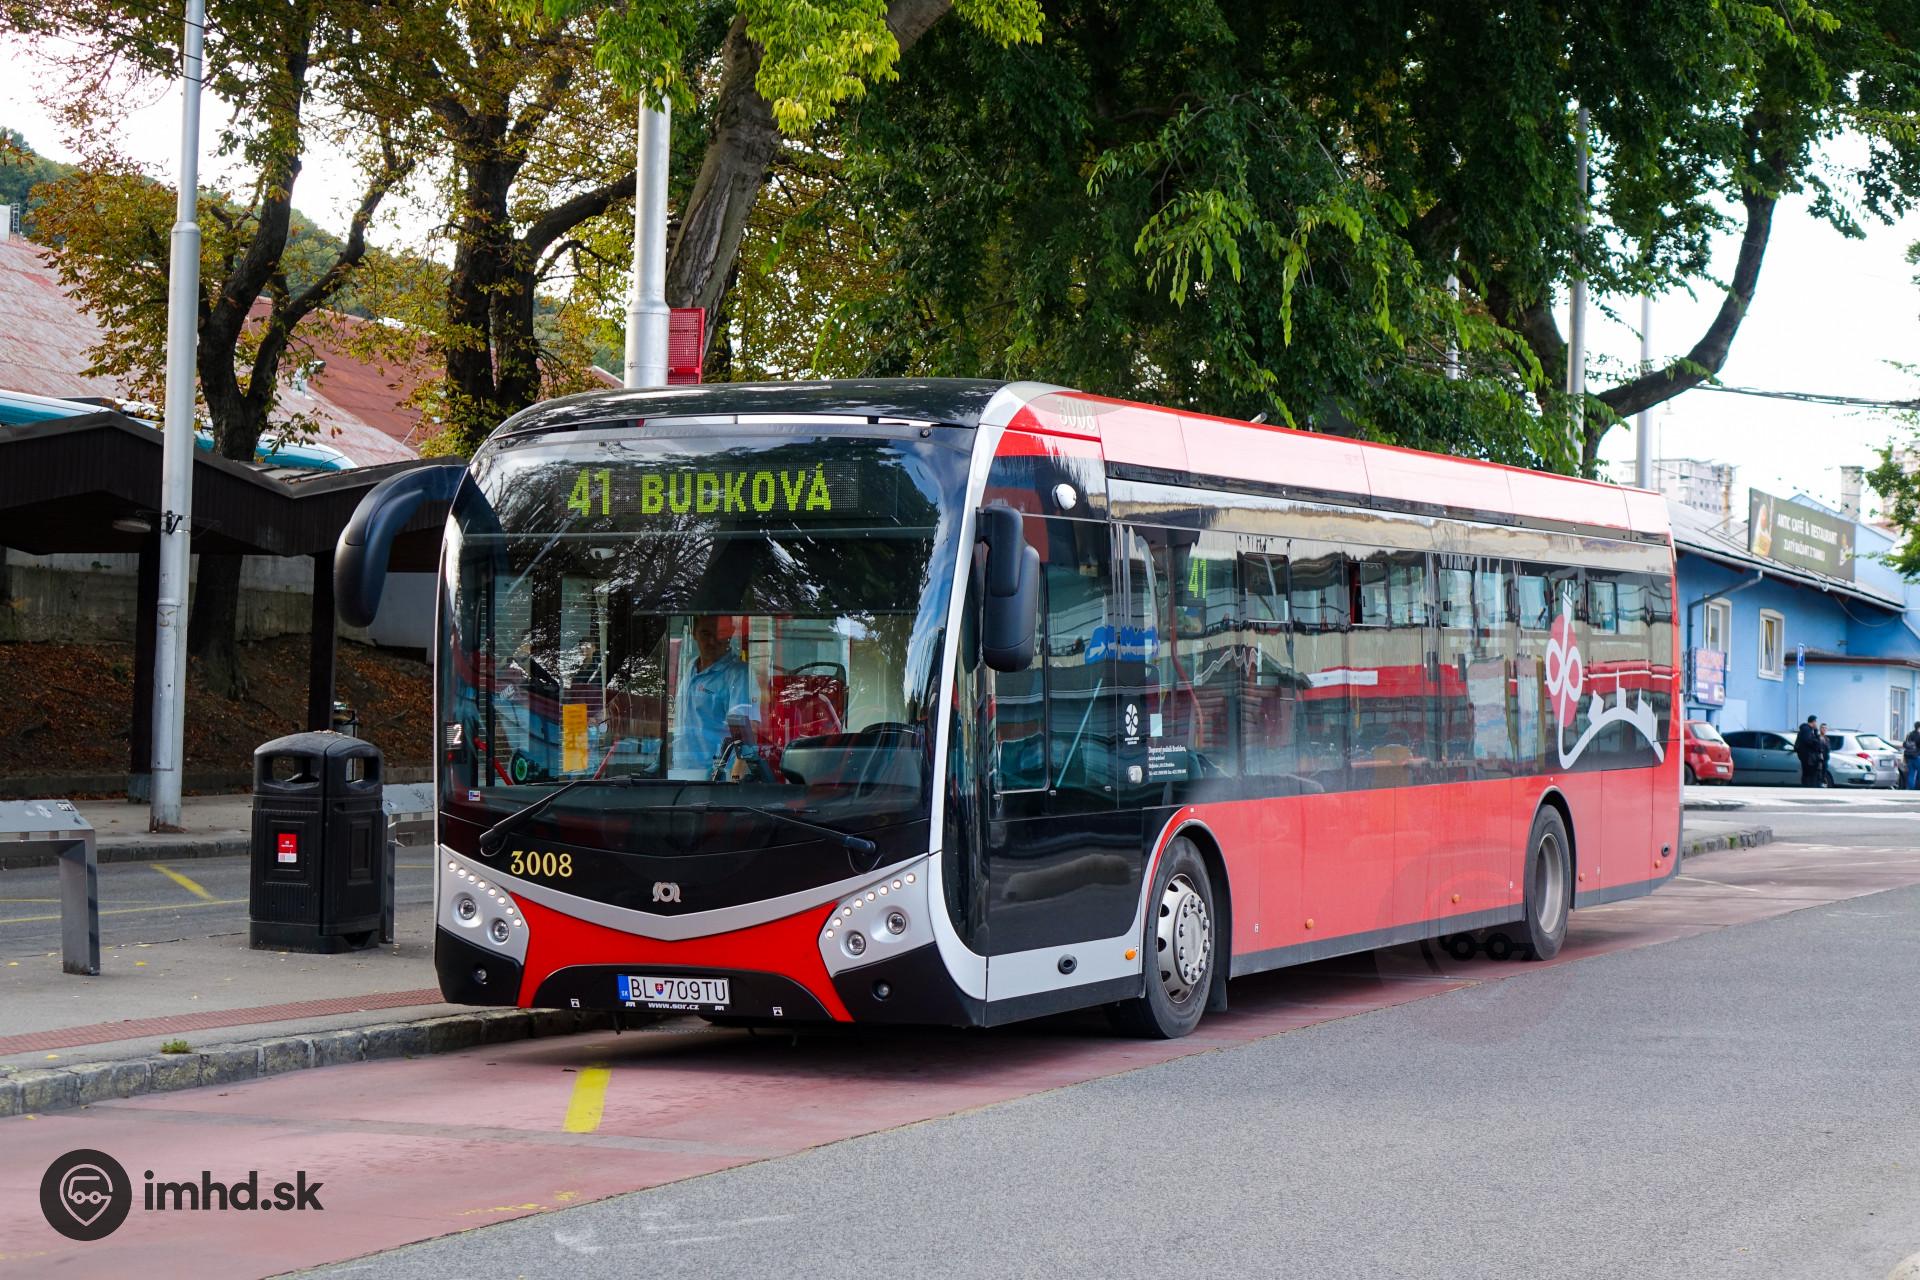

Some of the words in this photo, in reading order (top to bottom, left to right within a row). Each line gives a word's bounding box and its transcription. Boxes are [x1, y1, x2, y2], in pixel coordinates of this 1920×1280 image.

[567, 468, 611, 517] 41
[641, 461, 832, 514] BUDKOVÁ
[1187, 557, 1207, 599] 41
[453, 723, 462, 745] 2
[510, 850, 573, 877] 3008
